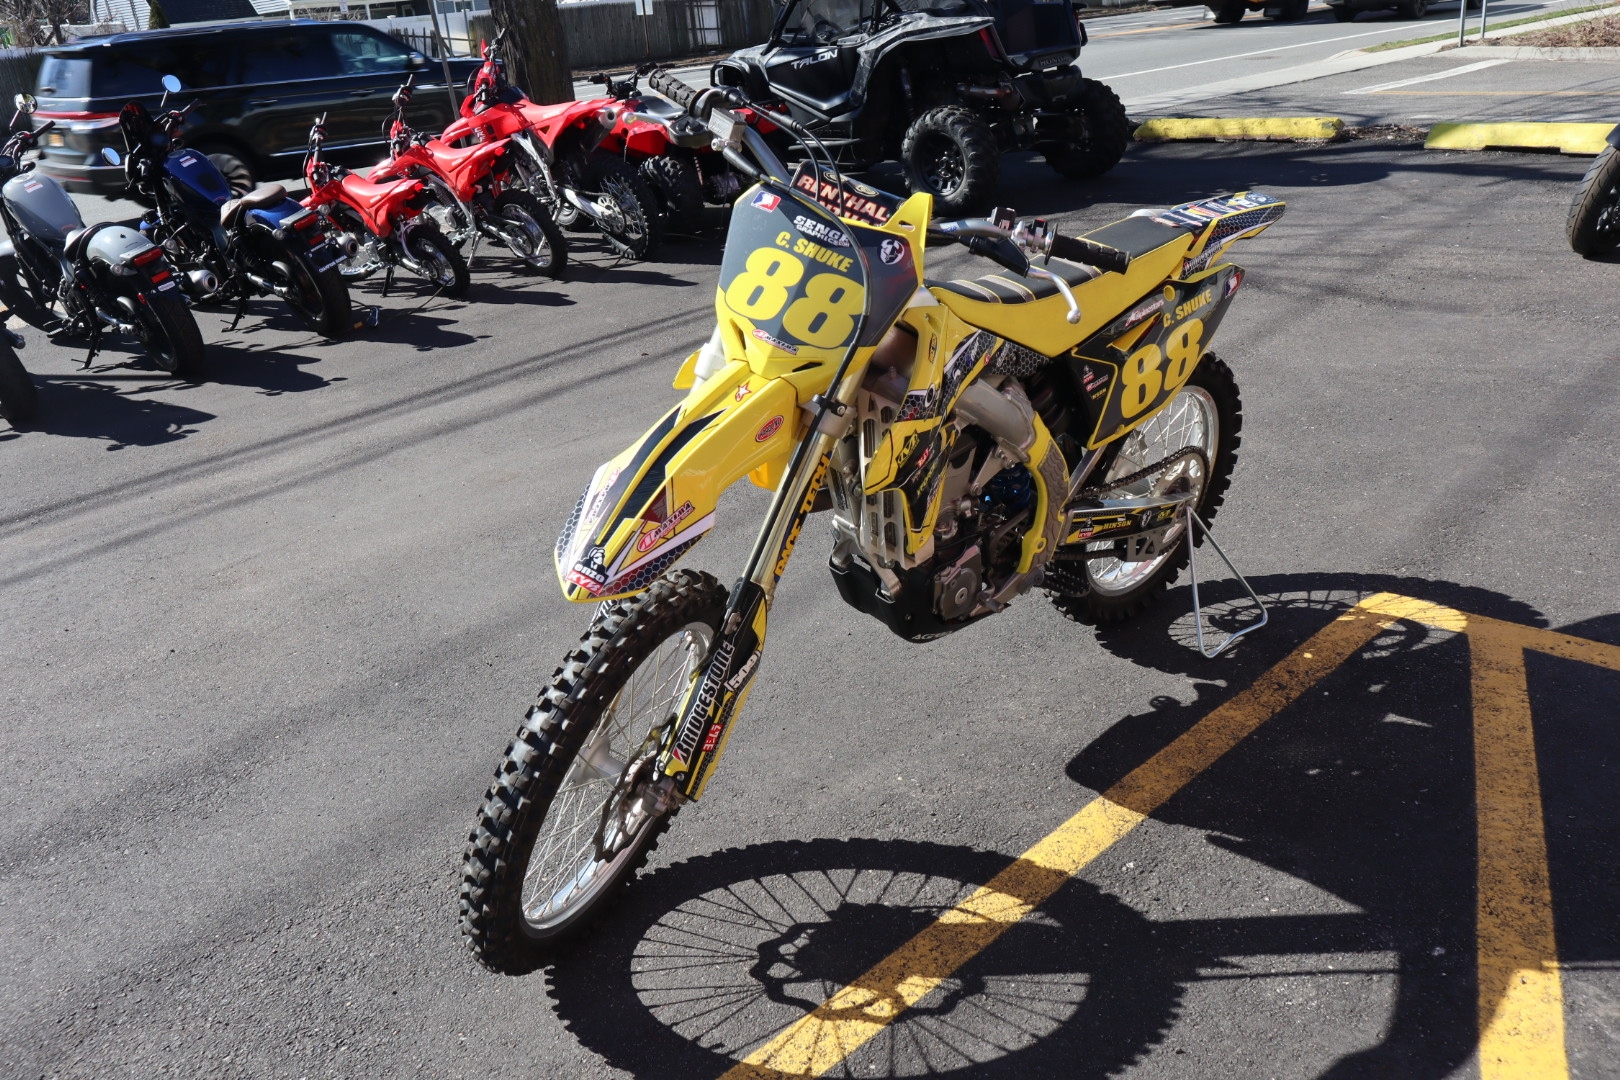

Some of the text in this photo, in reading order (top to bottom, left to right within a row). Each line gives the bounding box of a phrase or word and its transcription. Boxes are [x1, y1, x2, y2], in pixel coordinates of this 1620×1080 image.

[790, 48, 838, 70] TALON
[775, 231, 854, 274] C. SHUKE
[725, 246, 867, 349] 88
[1175, 288, 1213, 320] SHUKE
[1120, 317, 1204, 419] 88
[1103, 520, 1132, 530] HINSON
[566, 569, 602, 592] KYB
[572, 563, 606, 583] enzo
[671, 640, 736, 767] BRIDGESTONE
